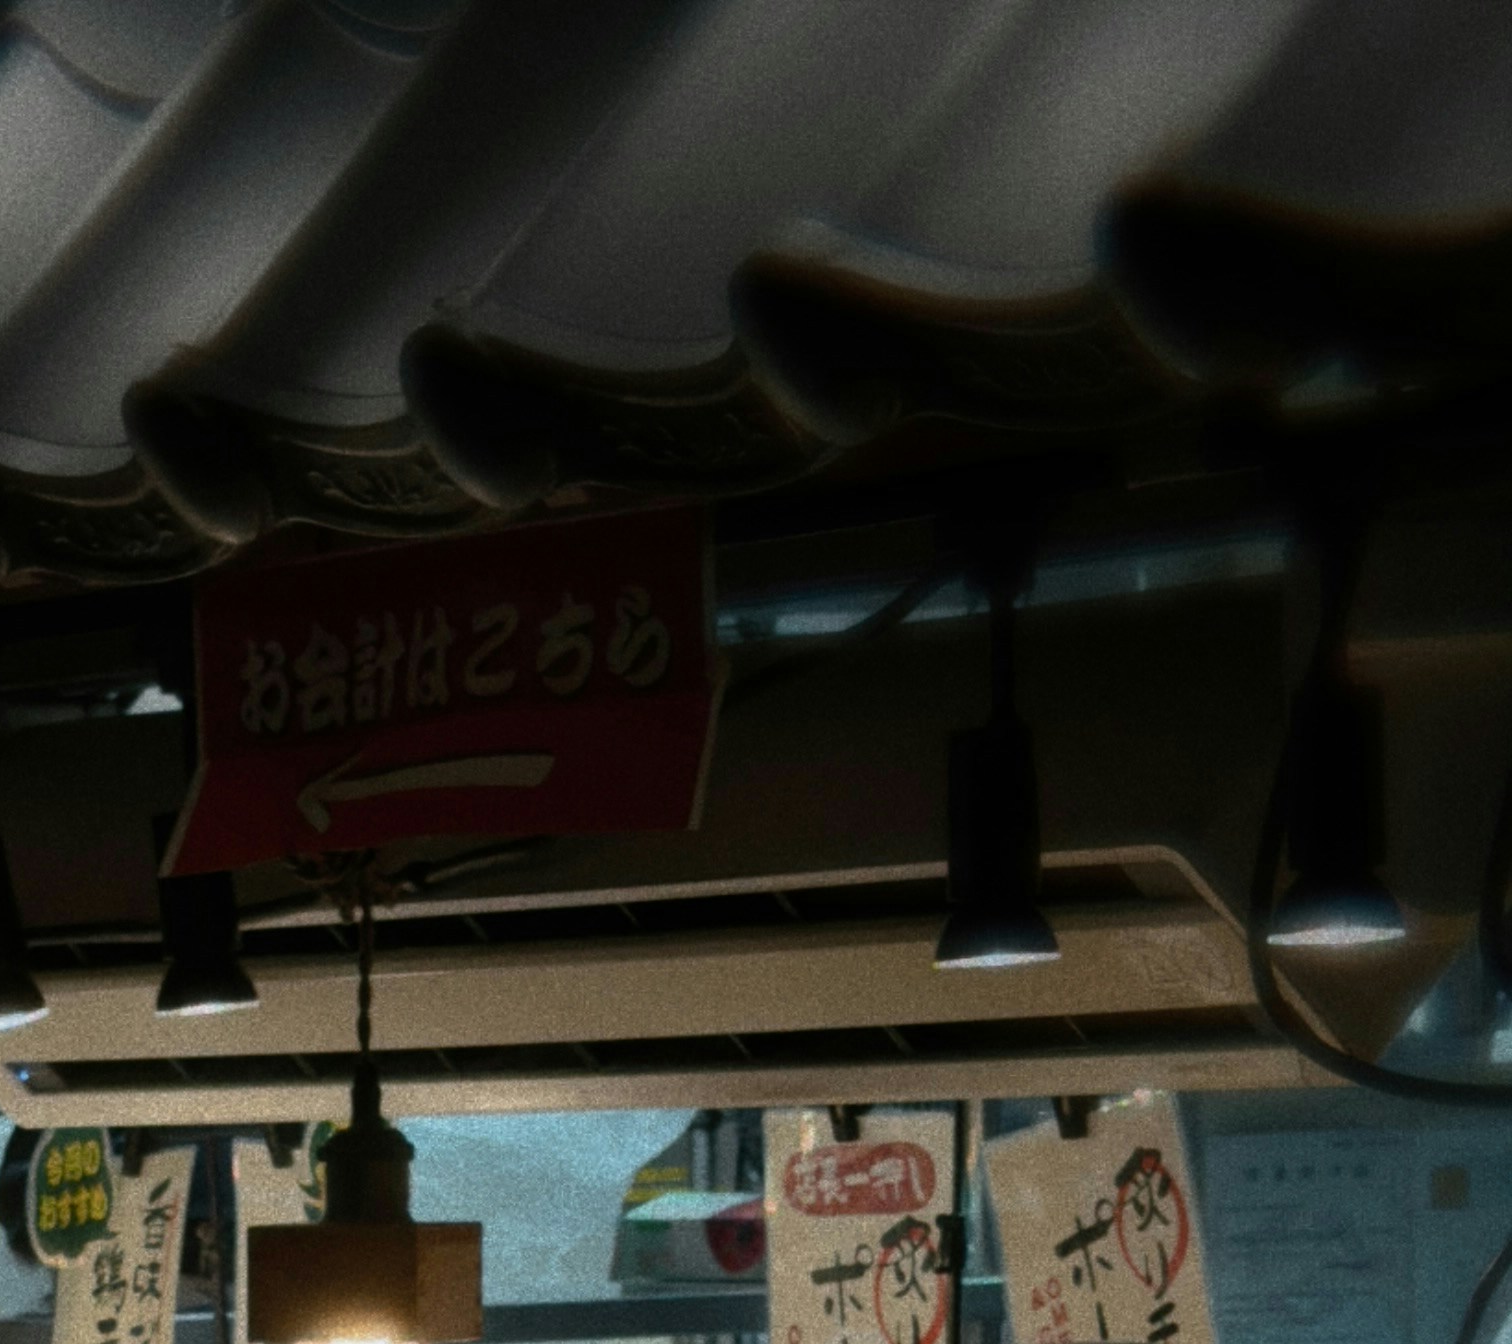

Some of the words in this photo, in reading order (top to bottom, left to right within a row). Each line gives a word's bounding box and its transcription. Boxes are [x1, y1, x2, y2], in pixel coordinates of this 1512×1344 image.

[239, 585, 672, 735] お会計はこちら
